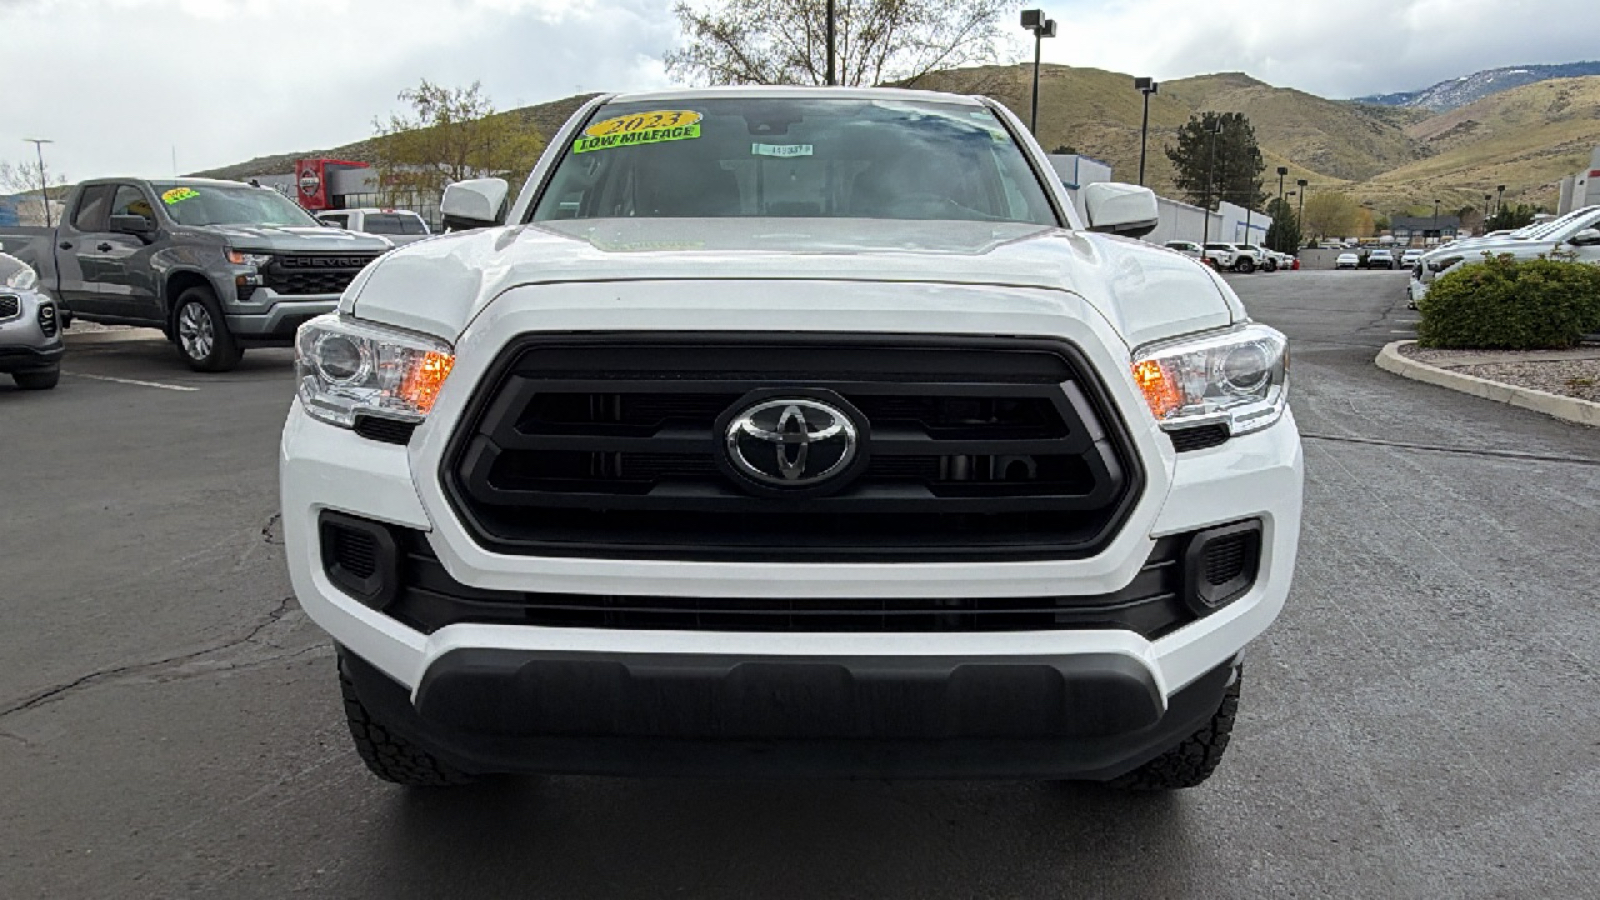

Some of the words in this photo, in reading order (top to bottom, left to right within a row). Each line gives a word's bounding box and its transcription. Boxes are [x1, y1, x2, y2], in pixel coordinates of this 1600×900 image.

[604, 113, 682, 134] 2023
[580, 135, 617, 150] LOW
[620, 127, 693, 143] MILEAGE
